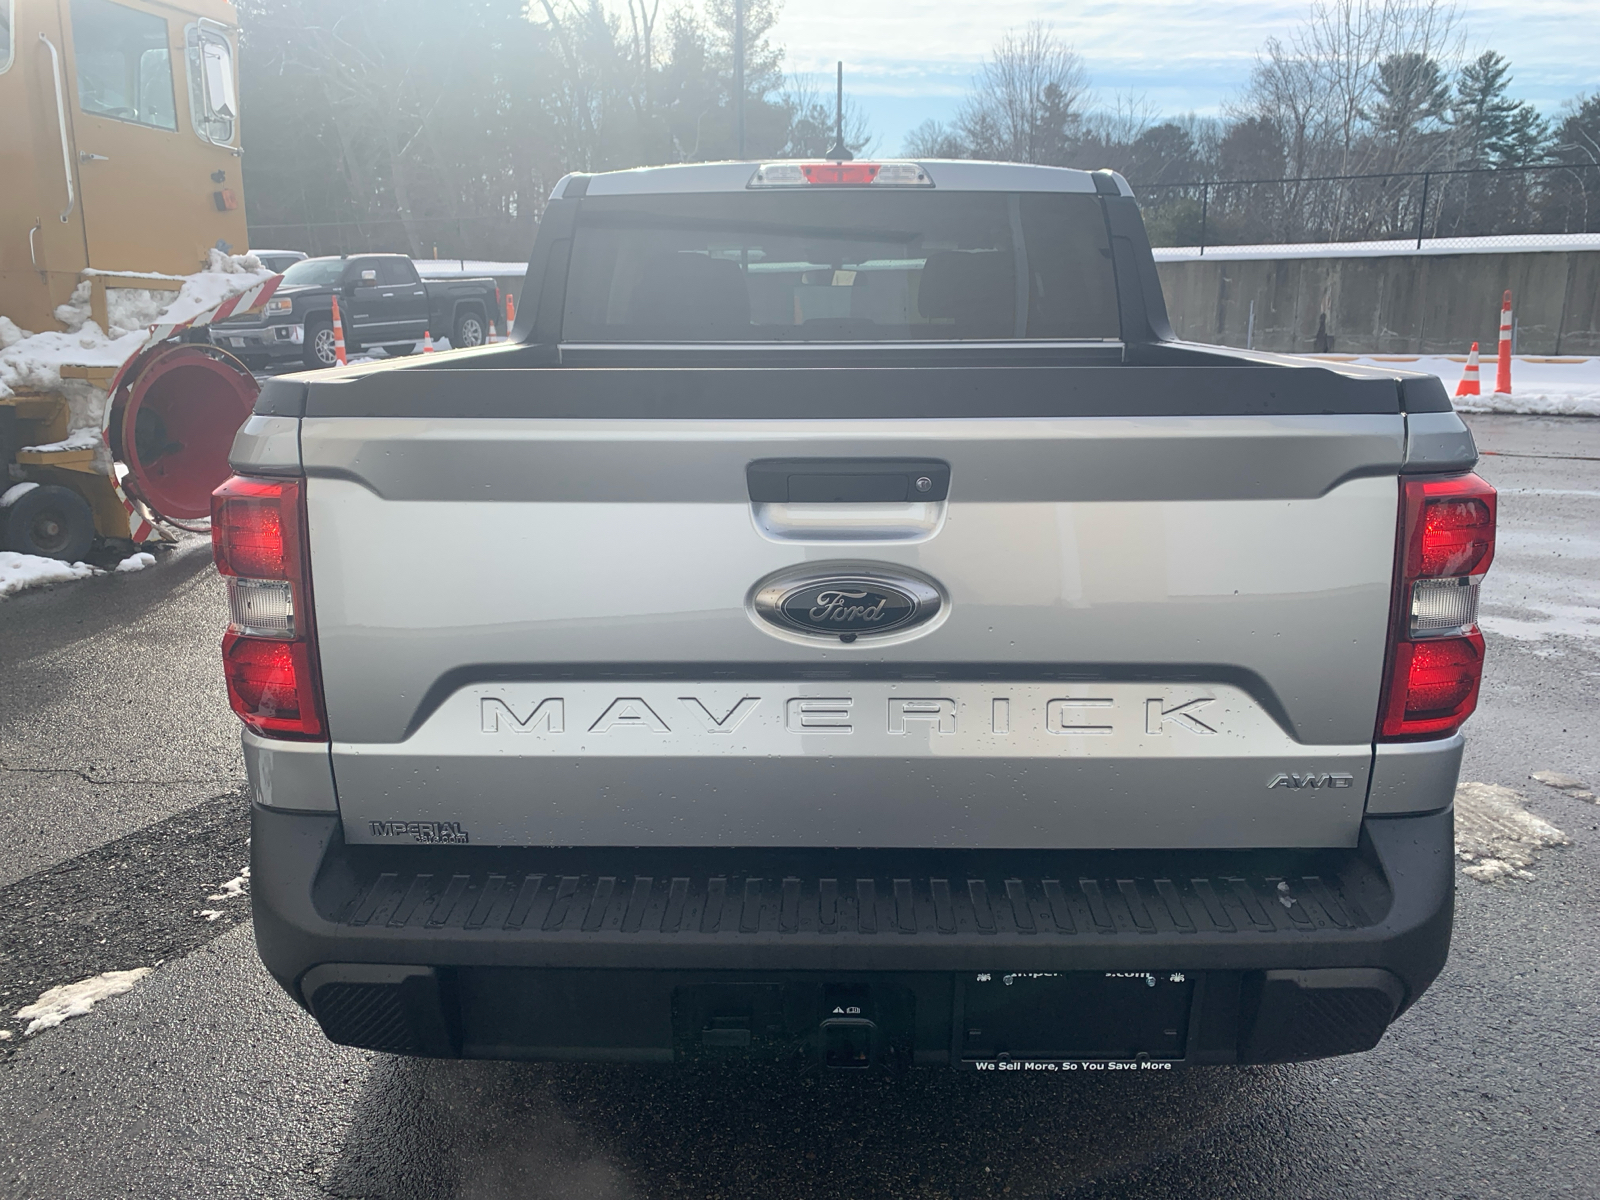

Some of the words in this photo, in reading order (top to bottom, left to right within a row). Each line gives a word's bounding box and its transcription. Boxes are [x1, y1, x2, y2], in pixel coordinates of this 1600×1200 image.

[809, 590, 887, 622] Ford
[481, 697, 1217, 734] MAVERICK
[1266, 773, 1354, 790] AWD
[368, 821, 468, 837] IMPERIAL
[975, 1062, 995, 1071] We
[998, 1062, 1021, 1071] Sell
[1024, 1062, 1058, 1072] More,
[1062, 1062, 1078, 1071] So
[1081, 1062, 1105, 1071] You
[1107, 1062, 1138, 1071] Save
[1140, 1062, 1172, 1071] More
